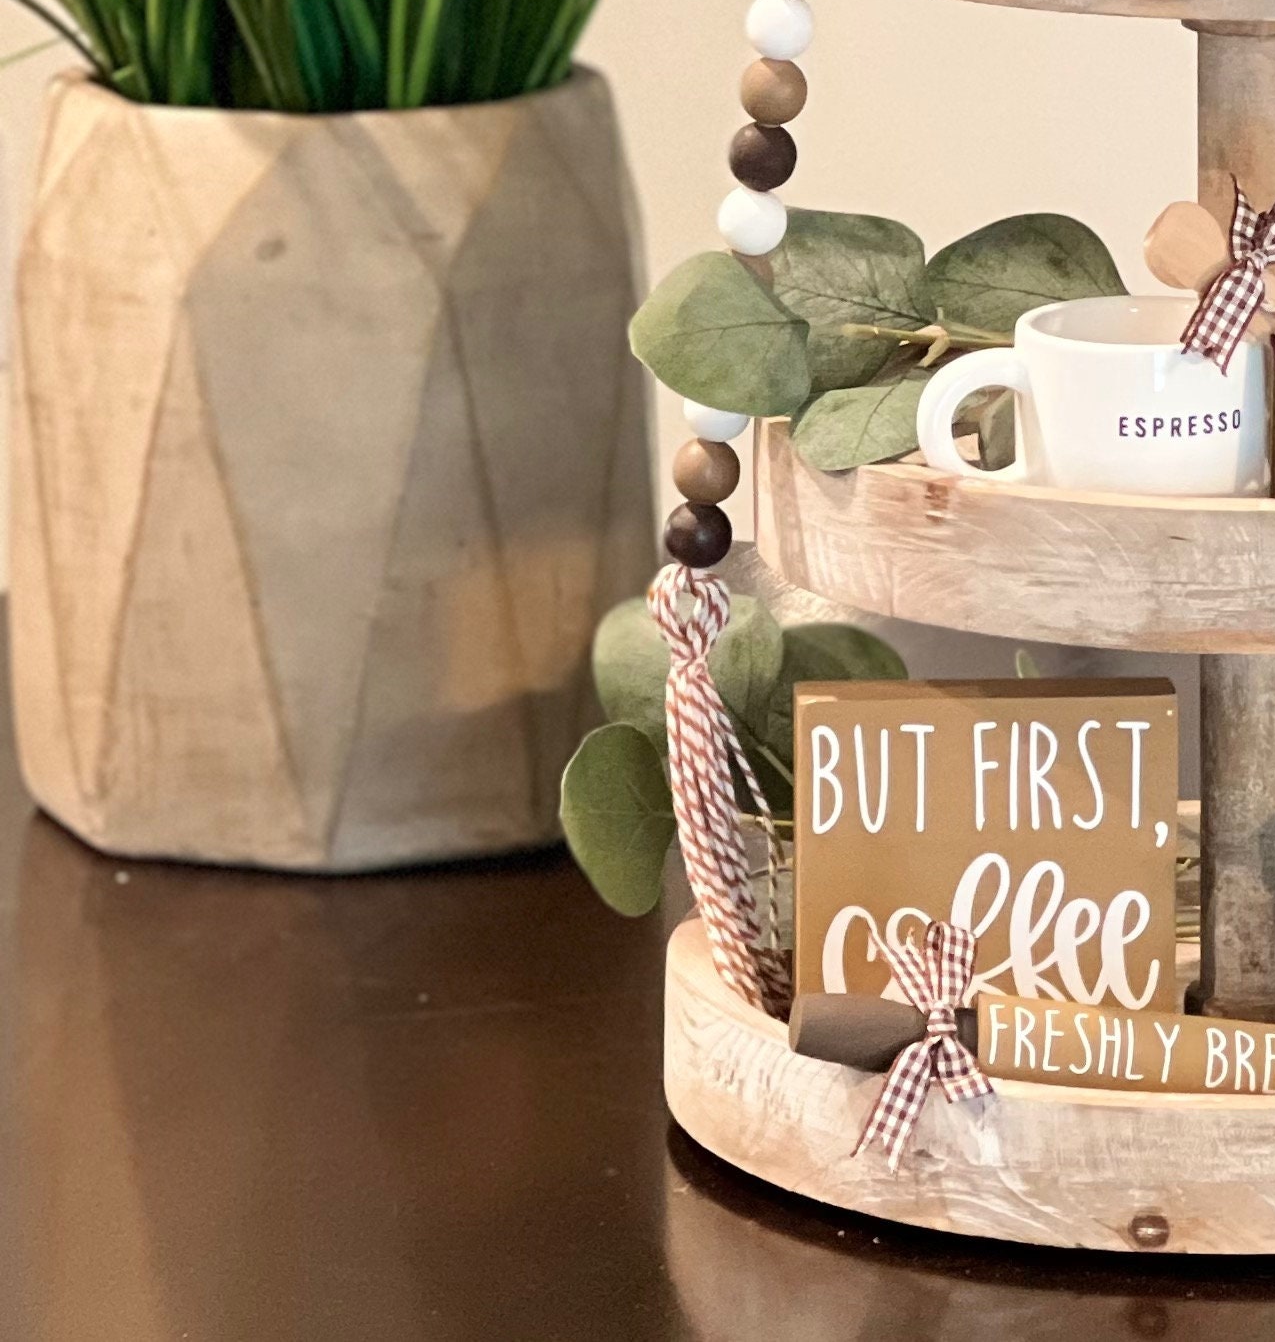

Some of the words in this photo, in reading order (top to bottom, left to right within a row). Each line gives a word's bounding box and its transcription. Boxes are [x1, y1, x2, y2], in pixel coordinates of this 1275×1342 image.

[1118, 408, 1242, 438] ESPRESSO
[810, 723, 935, 835] BUT
[971, 720, 1170, 849] FIRST,
[988, 1003, 1182, 1084] FRESHLY
